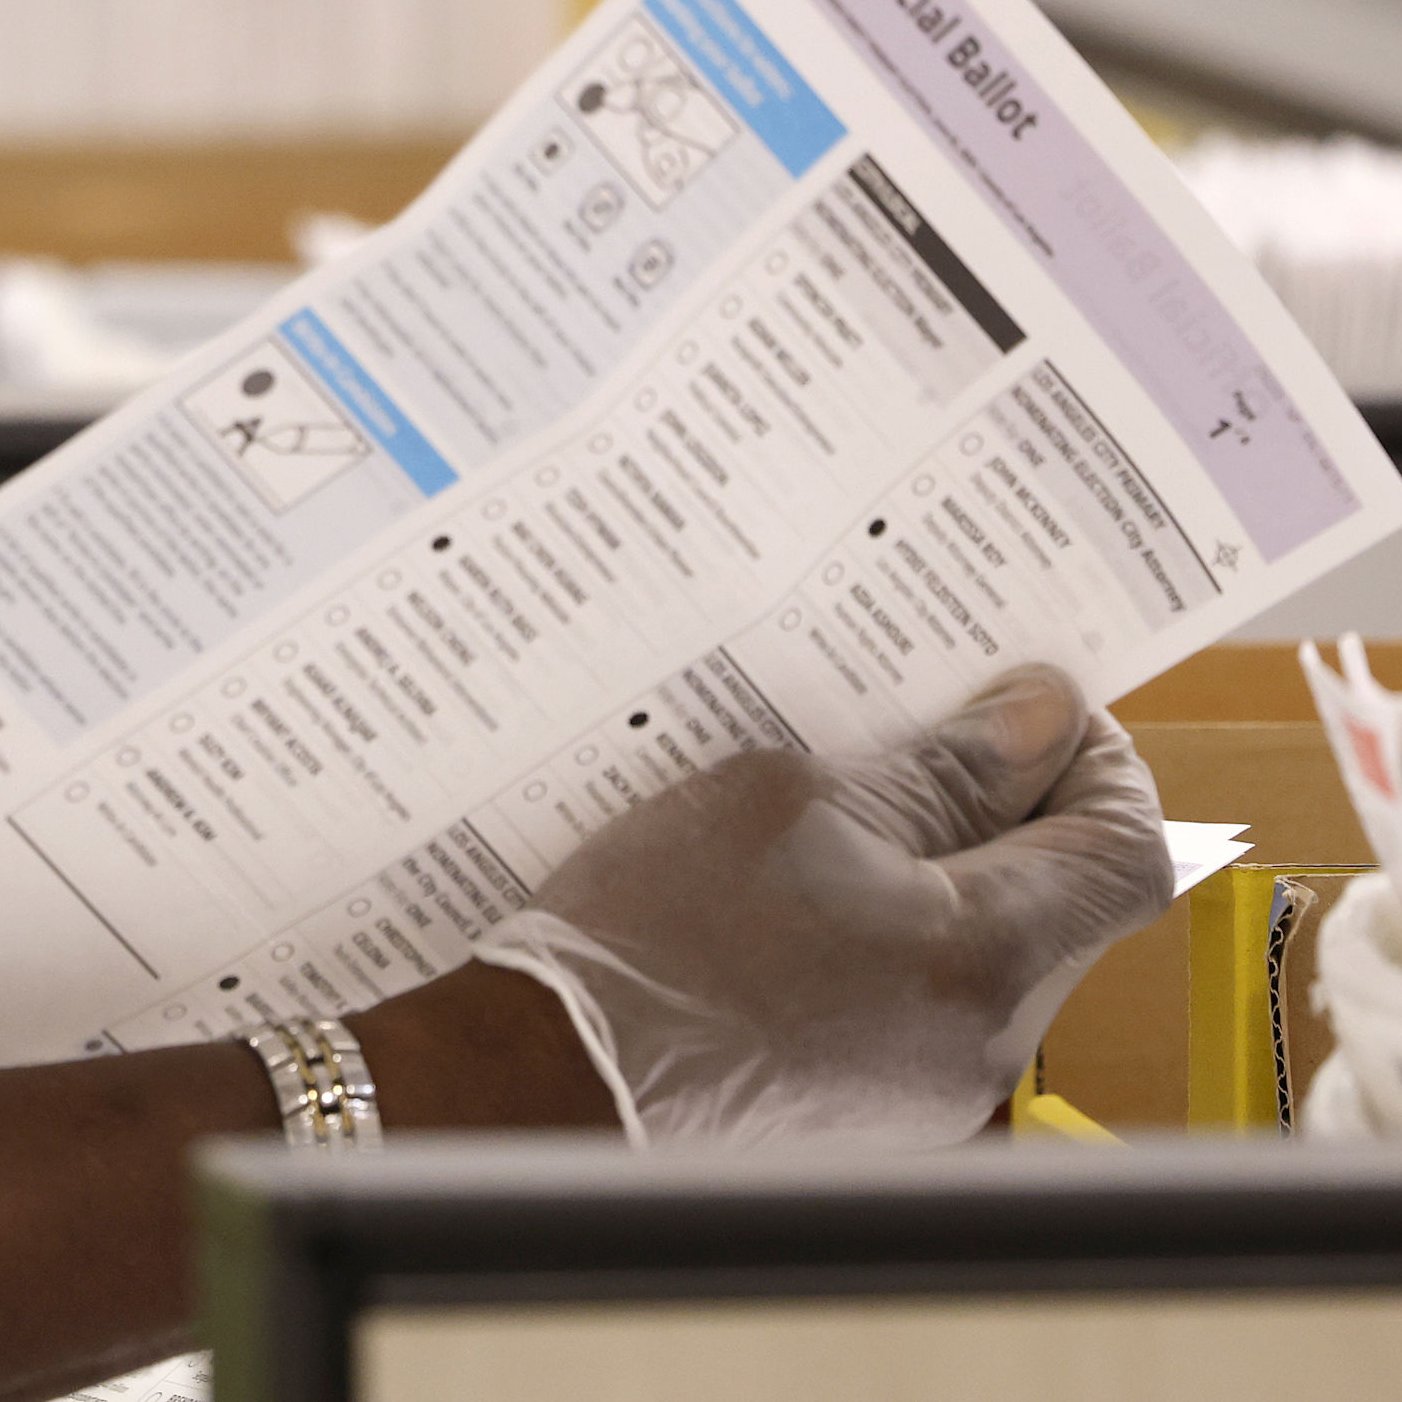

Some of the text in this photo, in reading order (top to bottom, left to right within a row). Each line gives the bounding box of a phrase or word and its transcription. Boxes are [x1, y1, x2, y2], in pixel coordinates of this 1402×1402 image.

[943, 34, 1044, 144] Ballot
[1009, 384, 1188, 616] NOMINATING ELECTION City Attorney
[1090, 441, 1118, 471] CITY
[1113, 469, 1167, 532] PRIMARY
